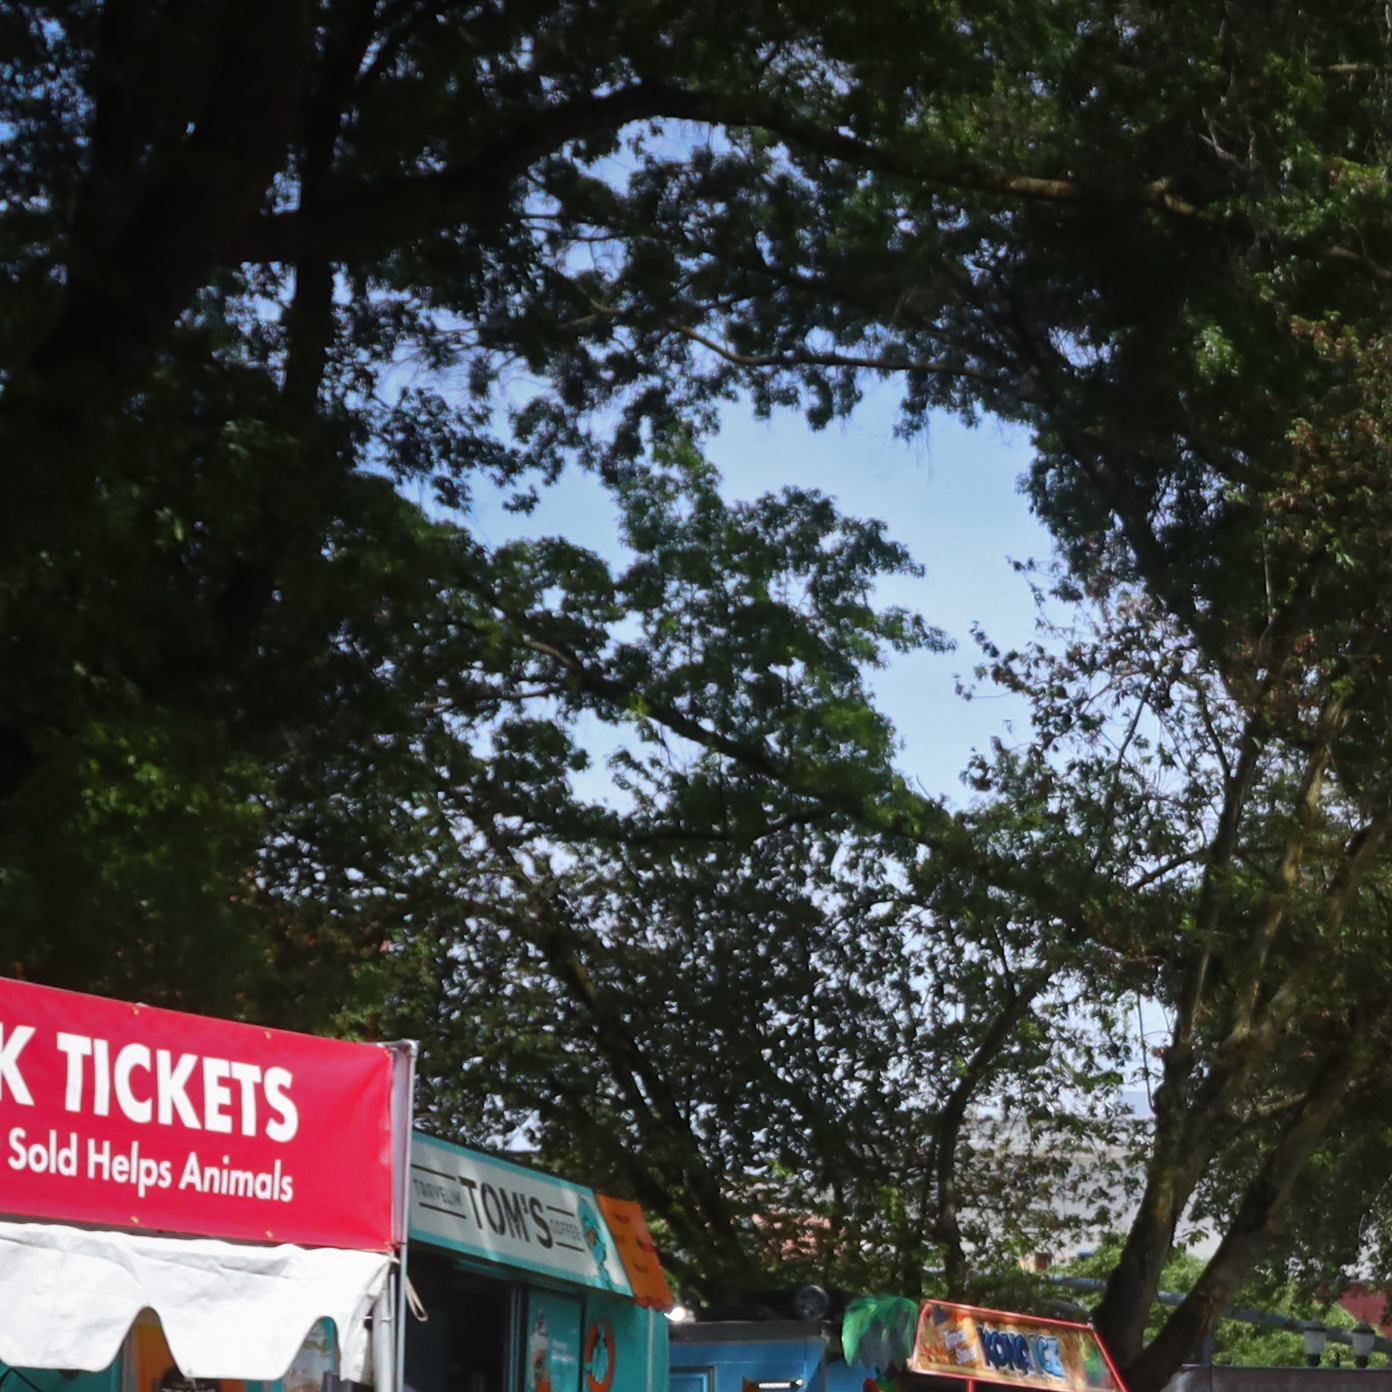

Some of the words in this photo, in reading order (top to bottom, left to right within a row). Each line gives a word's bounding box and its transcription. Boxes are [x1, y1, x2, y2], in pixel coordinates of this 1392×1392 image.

[57, 1032, 299, 1142] TICKETS
[7, 1127, 77, 1177] Sold
[88, 1137, 172, 1197] Helps
[180, 1152, 294, 1202] Animals
[458, 1176, 553, 1249] TOM'S
